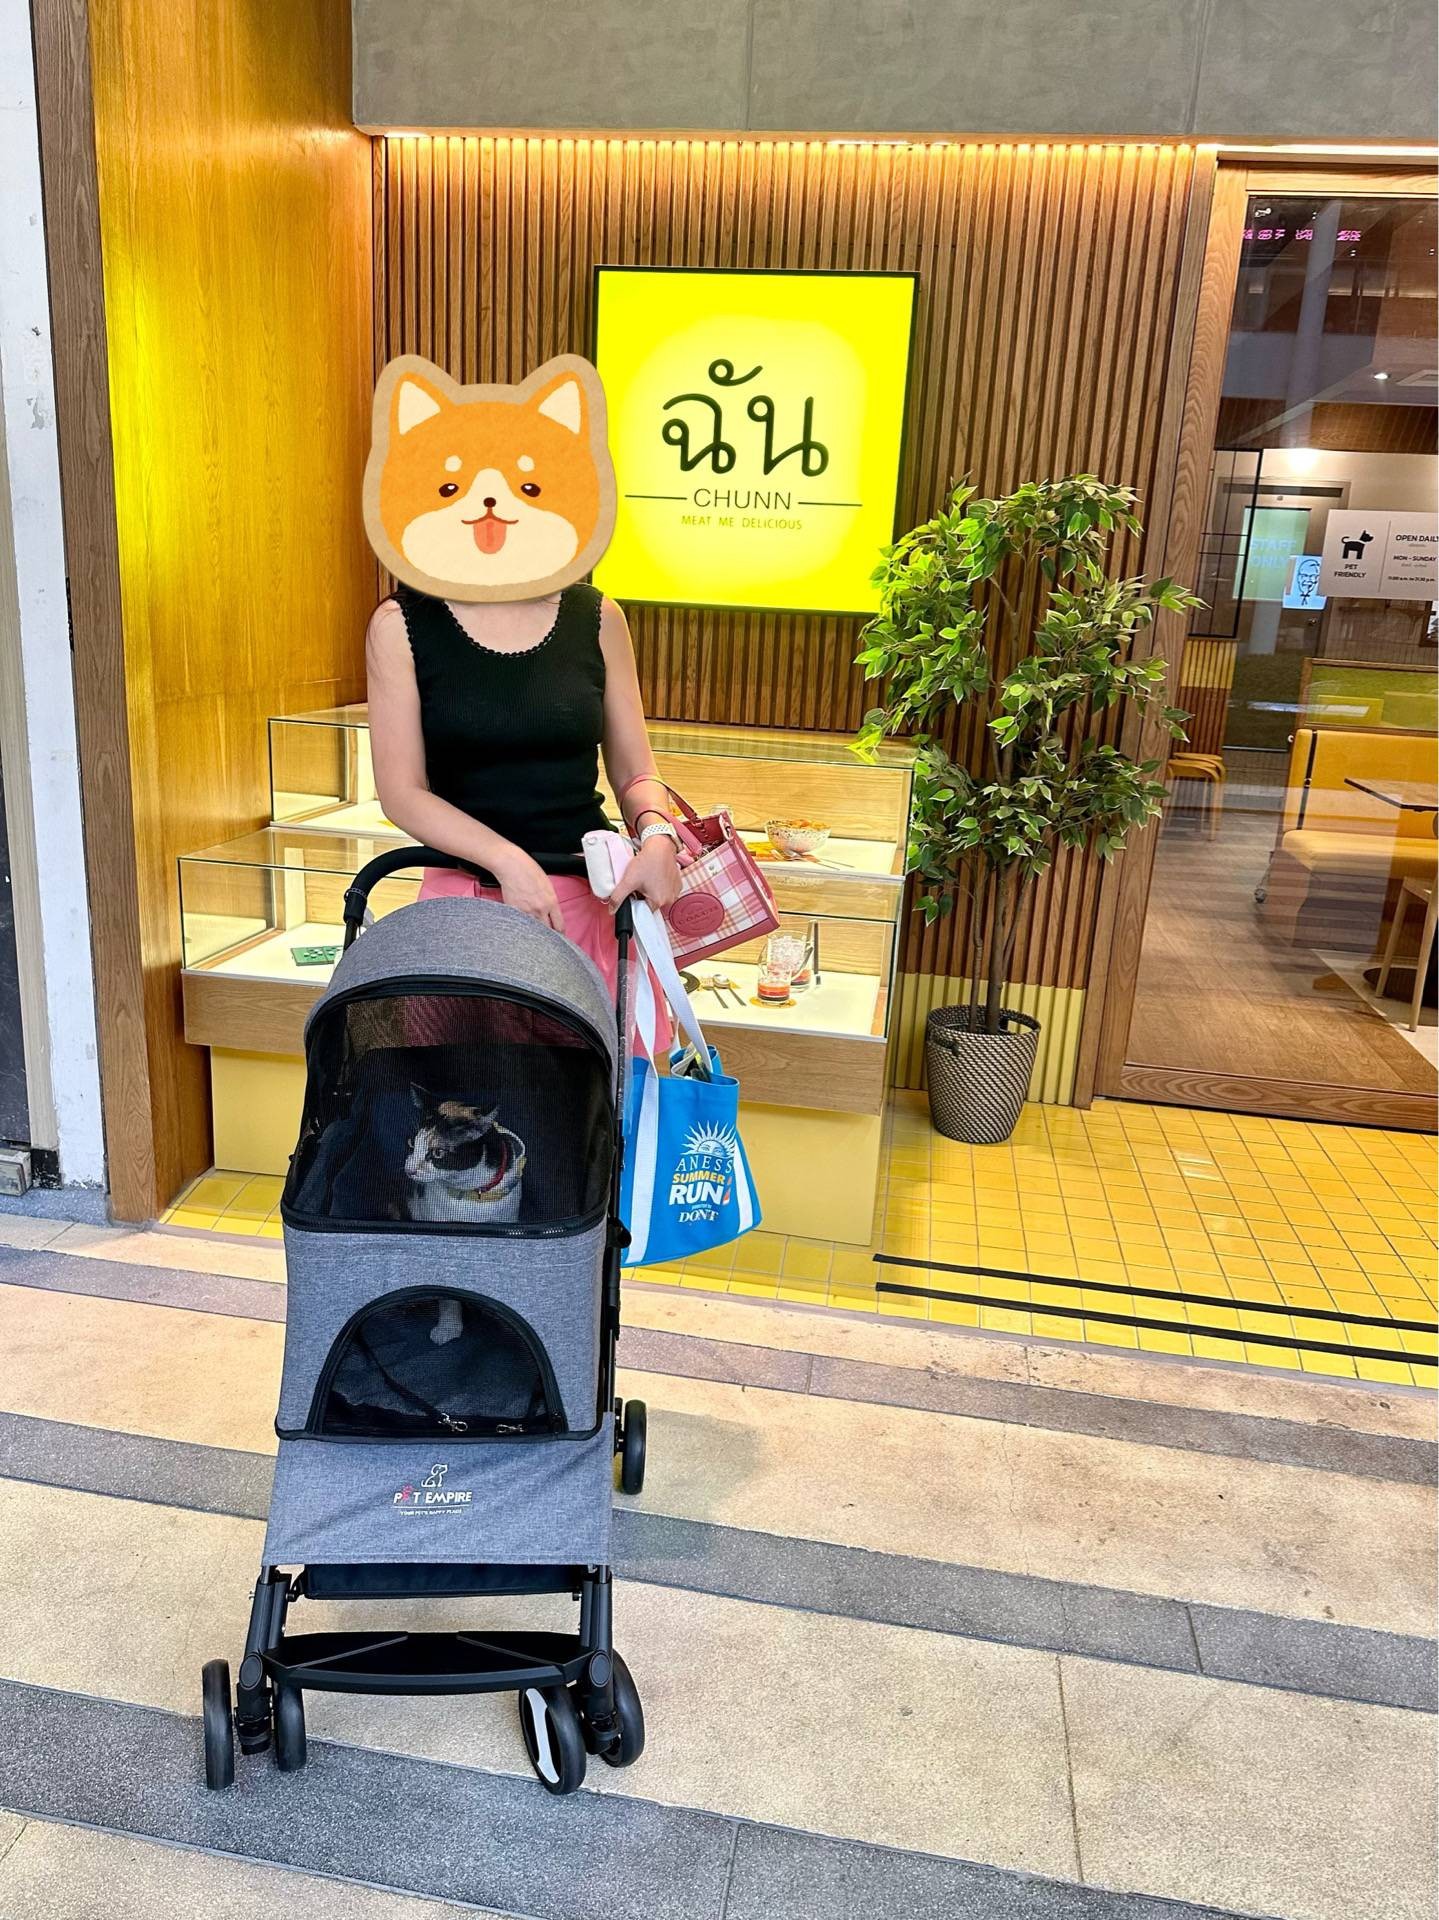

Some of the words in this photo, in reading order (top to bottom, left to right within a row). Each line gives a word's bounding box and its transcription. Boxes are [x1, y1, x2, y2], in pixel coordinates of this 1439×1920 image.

[662, 358, 829, 477] ฉัน
[693, 488, 791, 510] CHUNN
[681, 515, 712, 526] MEAT
[719, 517, 734, 527] ME
[742, 517, 803, 530] DELICIOUS
[1395, 534, 1418, 542] OPEN
[672, 1170, 726, 1185] SUMMER
[668, 1181, 724, 1206] RUN
[425, 1491, 473, 1504] EMPIRE
